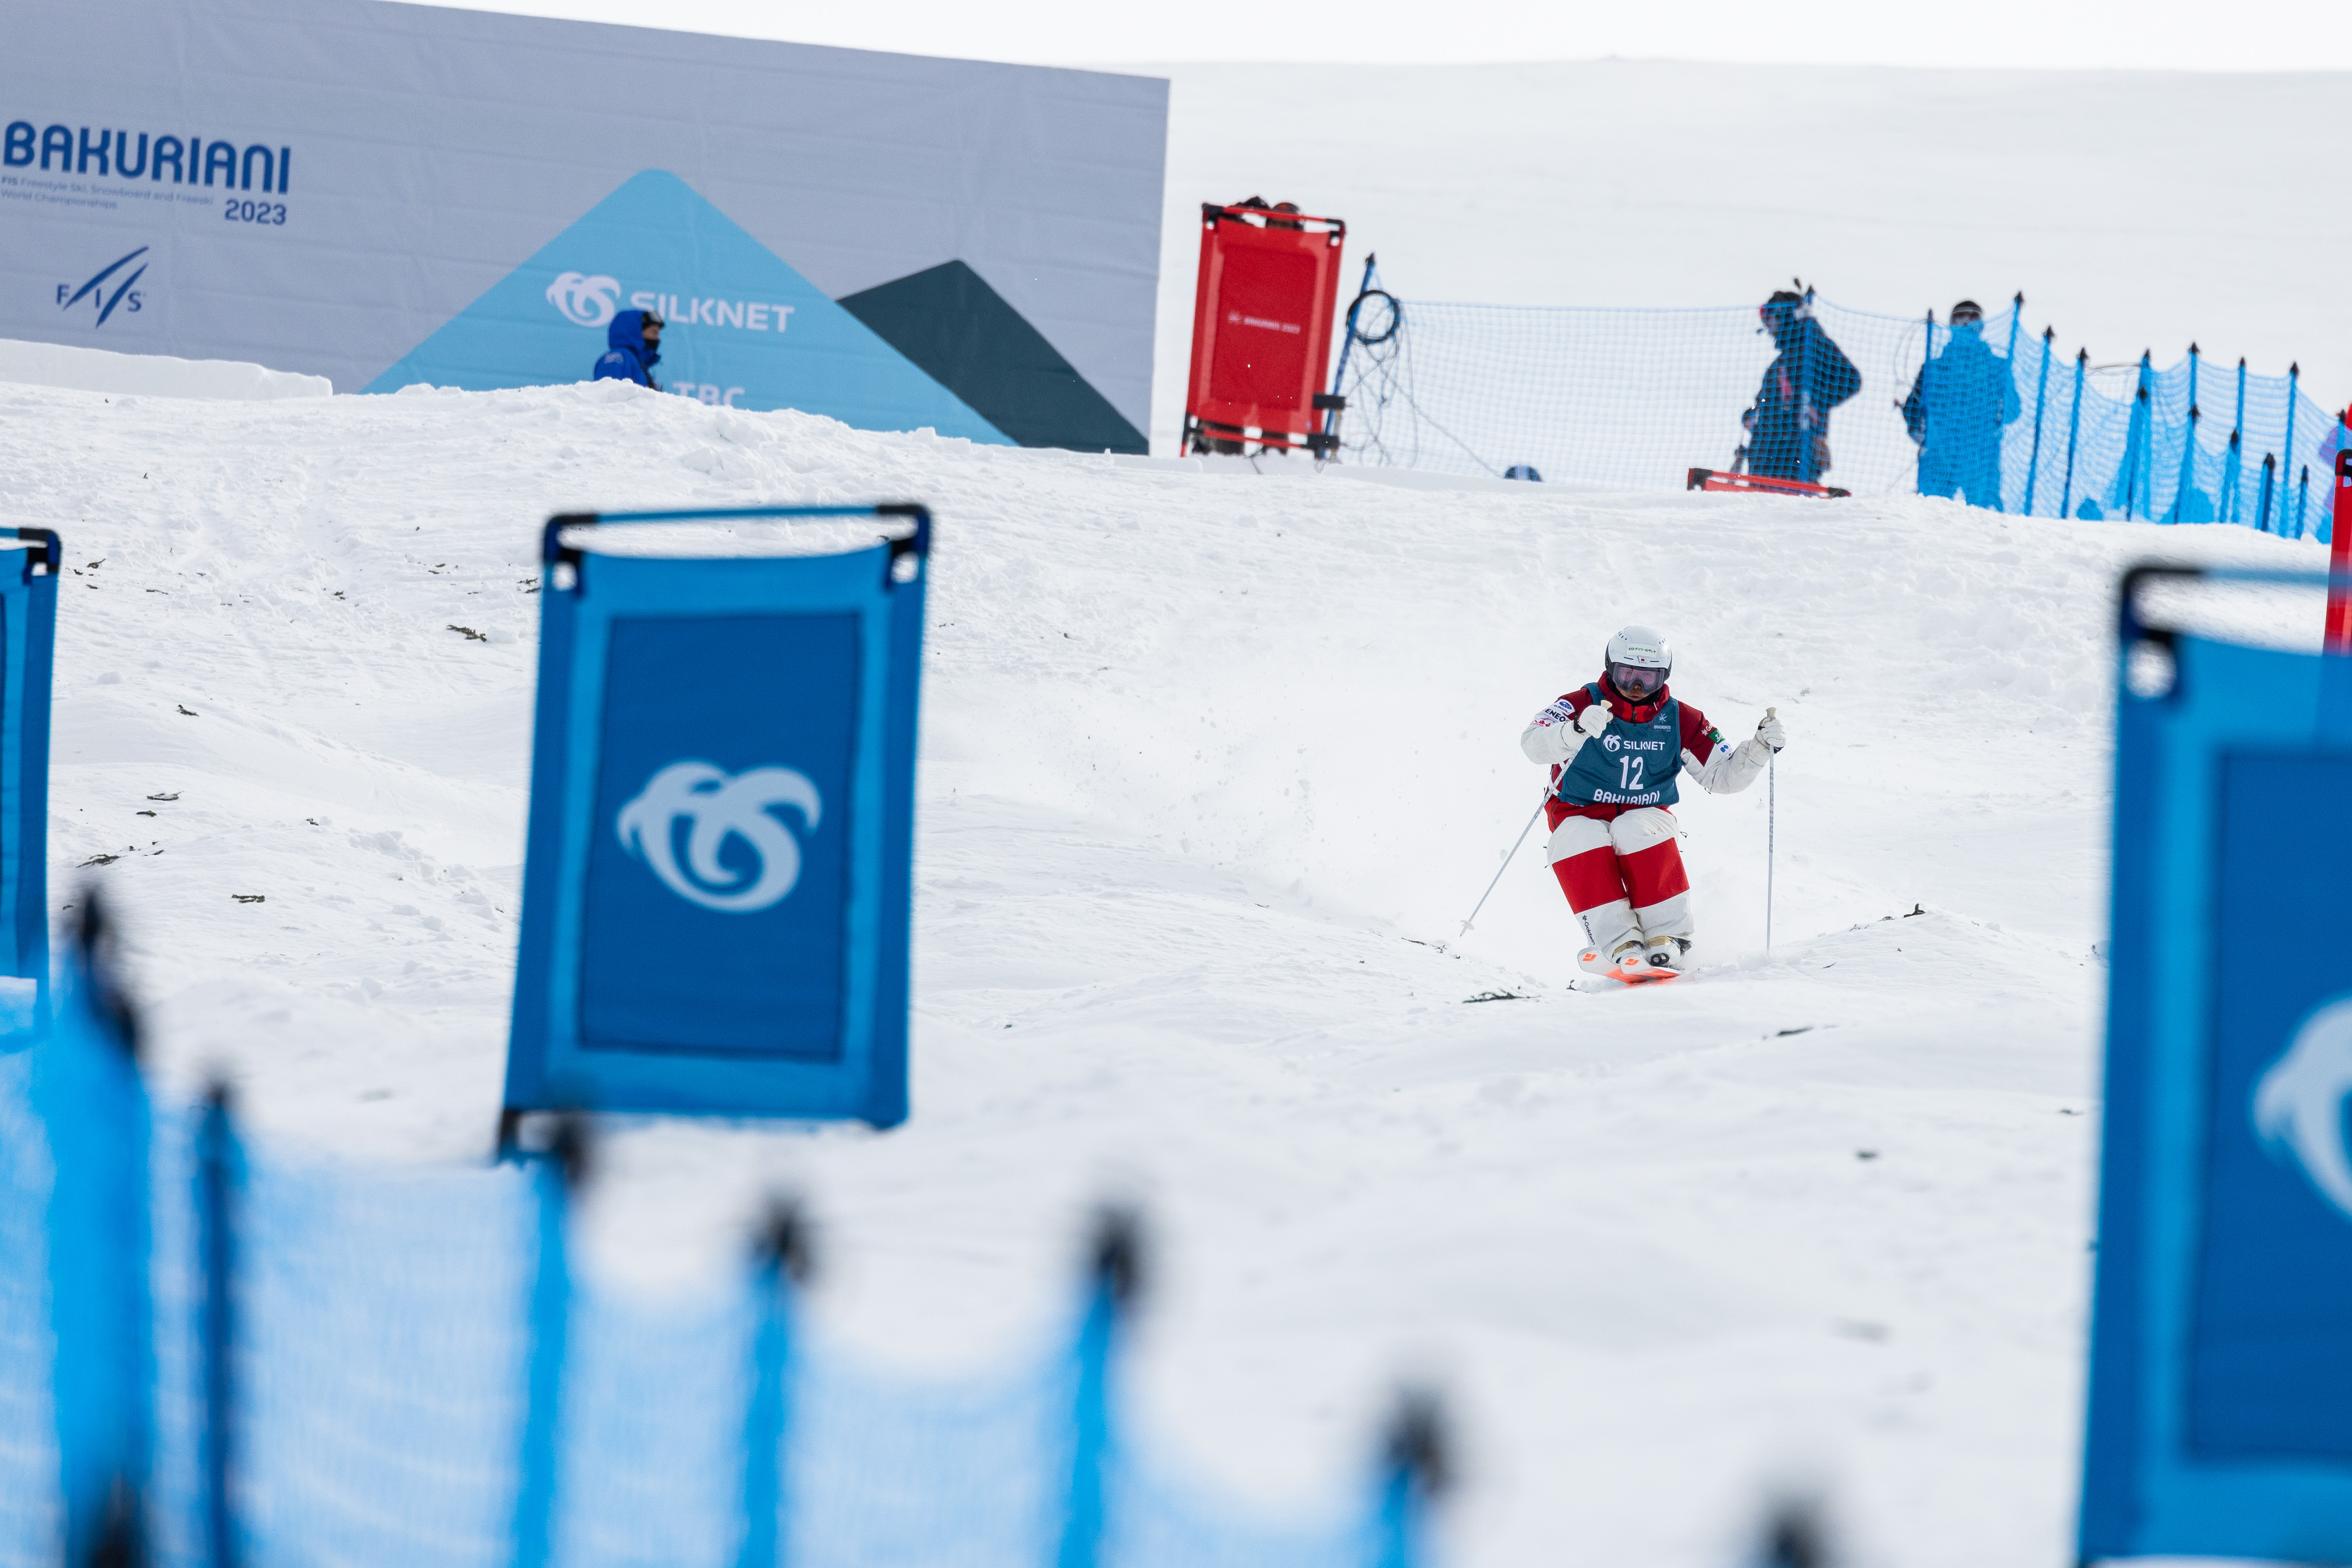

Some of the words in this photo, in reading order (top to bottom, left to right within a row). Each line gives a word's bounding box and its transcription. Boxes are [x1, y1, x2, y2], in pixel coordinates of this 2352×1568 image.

[3, 121, 291, 195] BAKURIANI
[224, 198, 287, 225] 2023
[630, 290, 795, 333] SILKNET
[1553, 705, 1570, 714] SUBARU
[1624, 740, 1665, 751] SILKNET
[1620, 755, 1644, 790] 12
[1593, 788, 1660, 805] BAKURIANI
[1585, 922, 1596, 945] Goldwin
